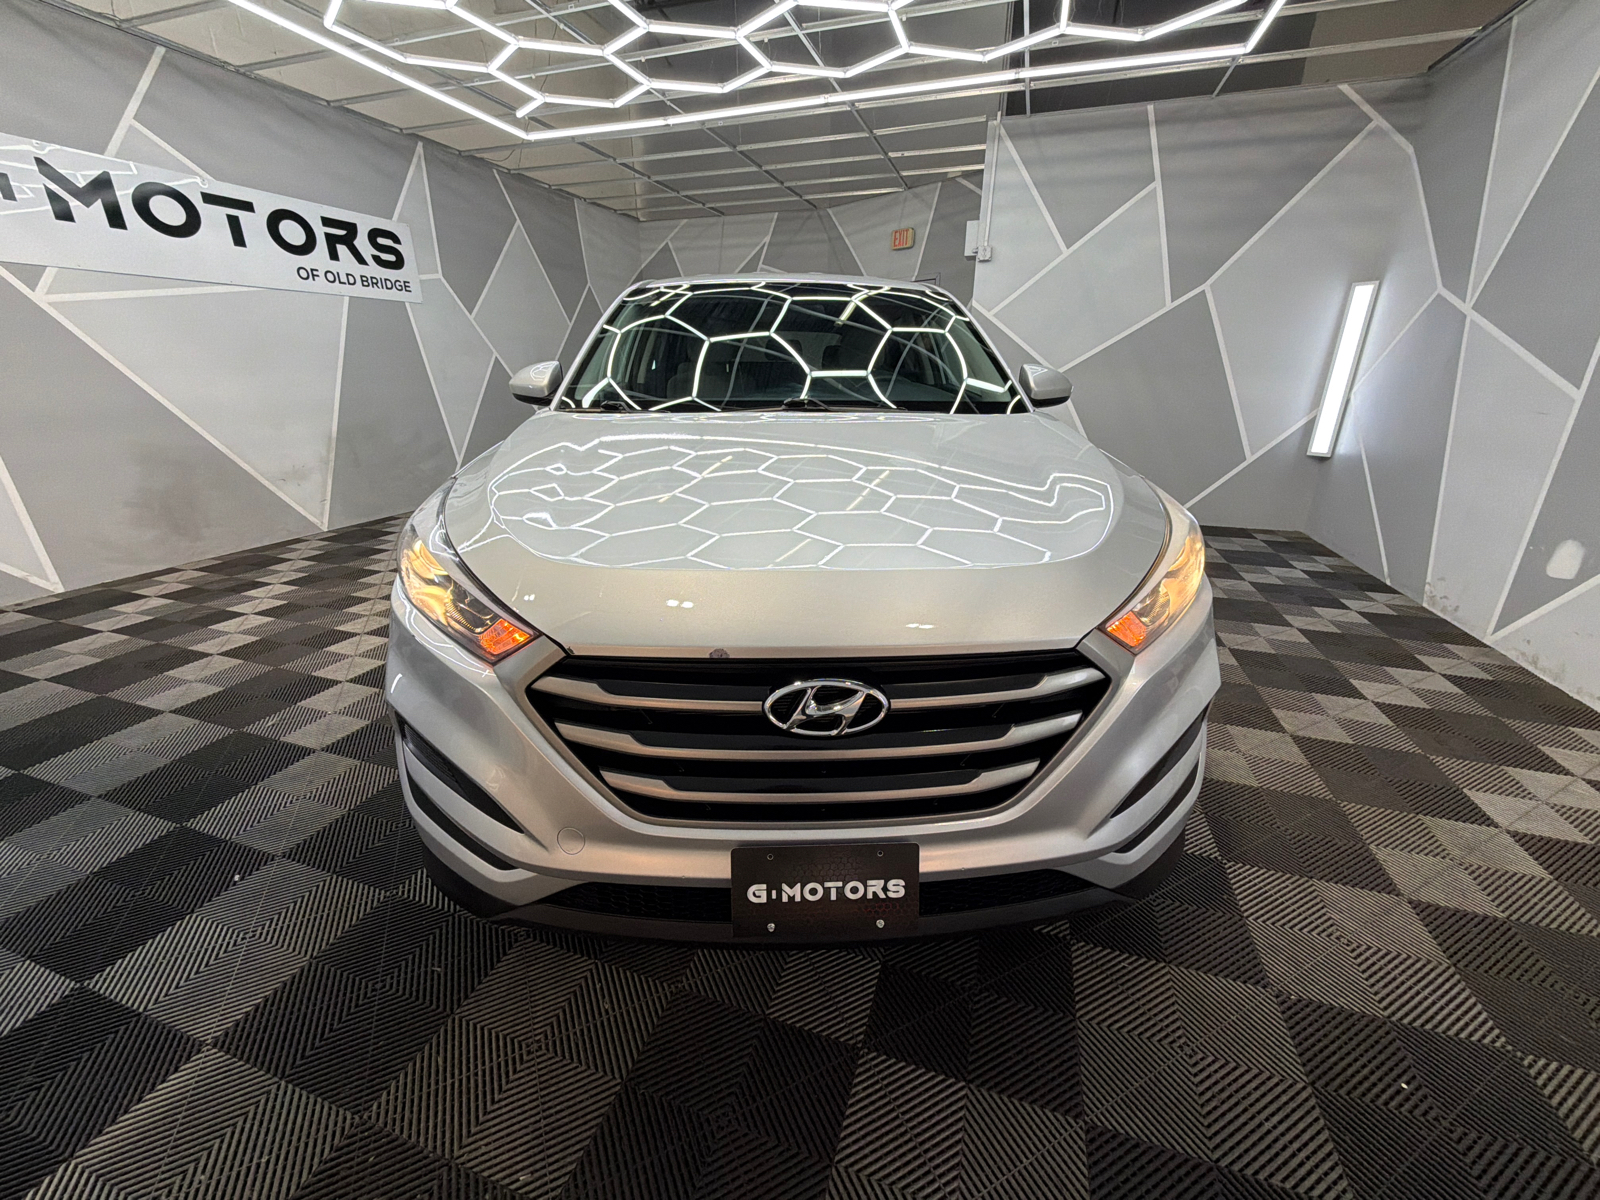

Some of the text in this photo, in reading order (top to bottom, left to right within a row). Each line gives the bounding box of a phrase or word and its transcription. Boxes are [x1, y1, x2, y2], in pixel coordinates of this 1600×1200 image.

[33, 156, 406, 271] MOTORS
[893, 228, 909, 248] EXIT
[296, 266, 412, 293] OF OLD BRIDGE
